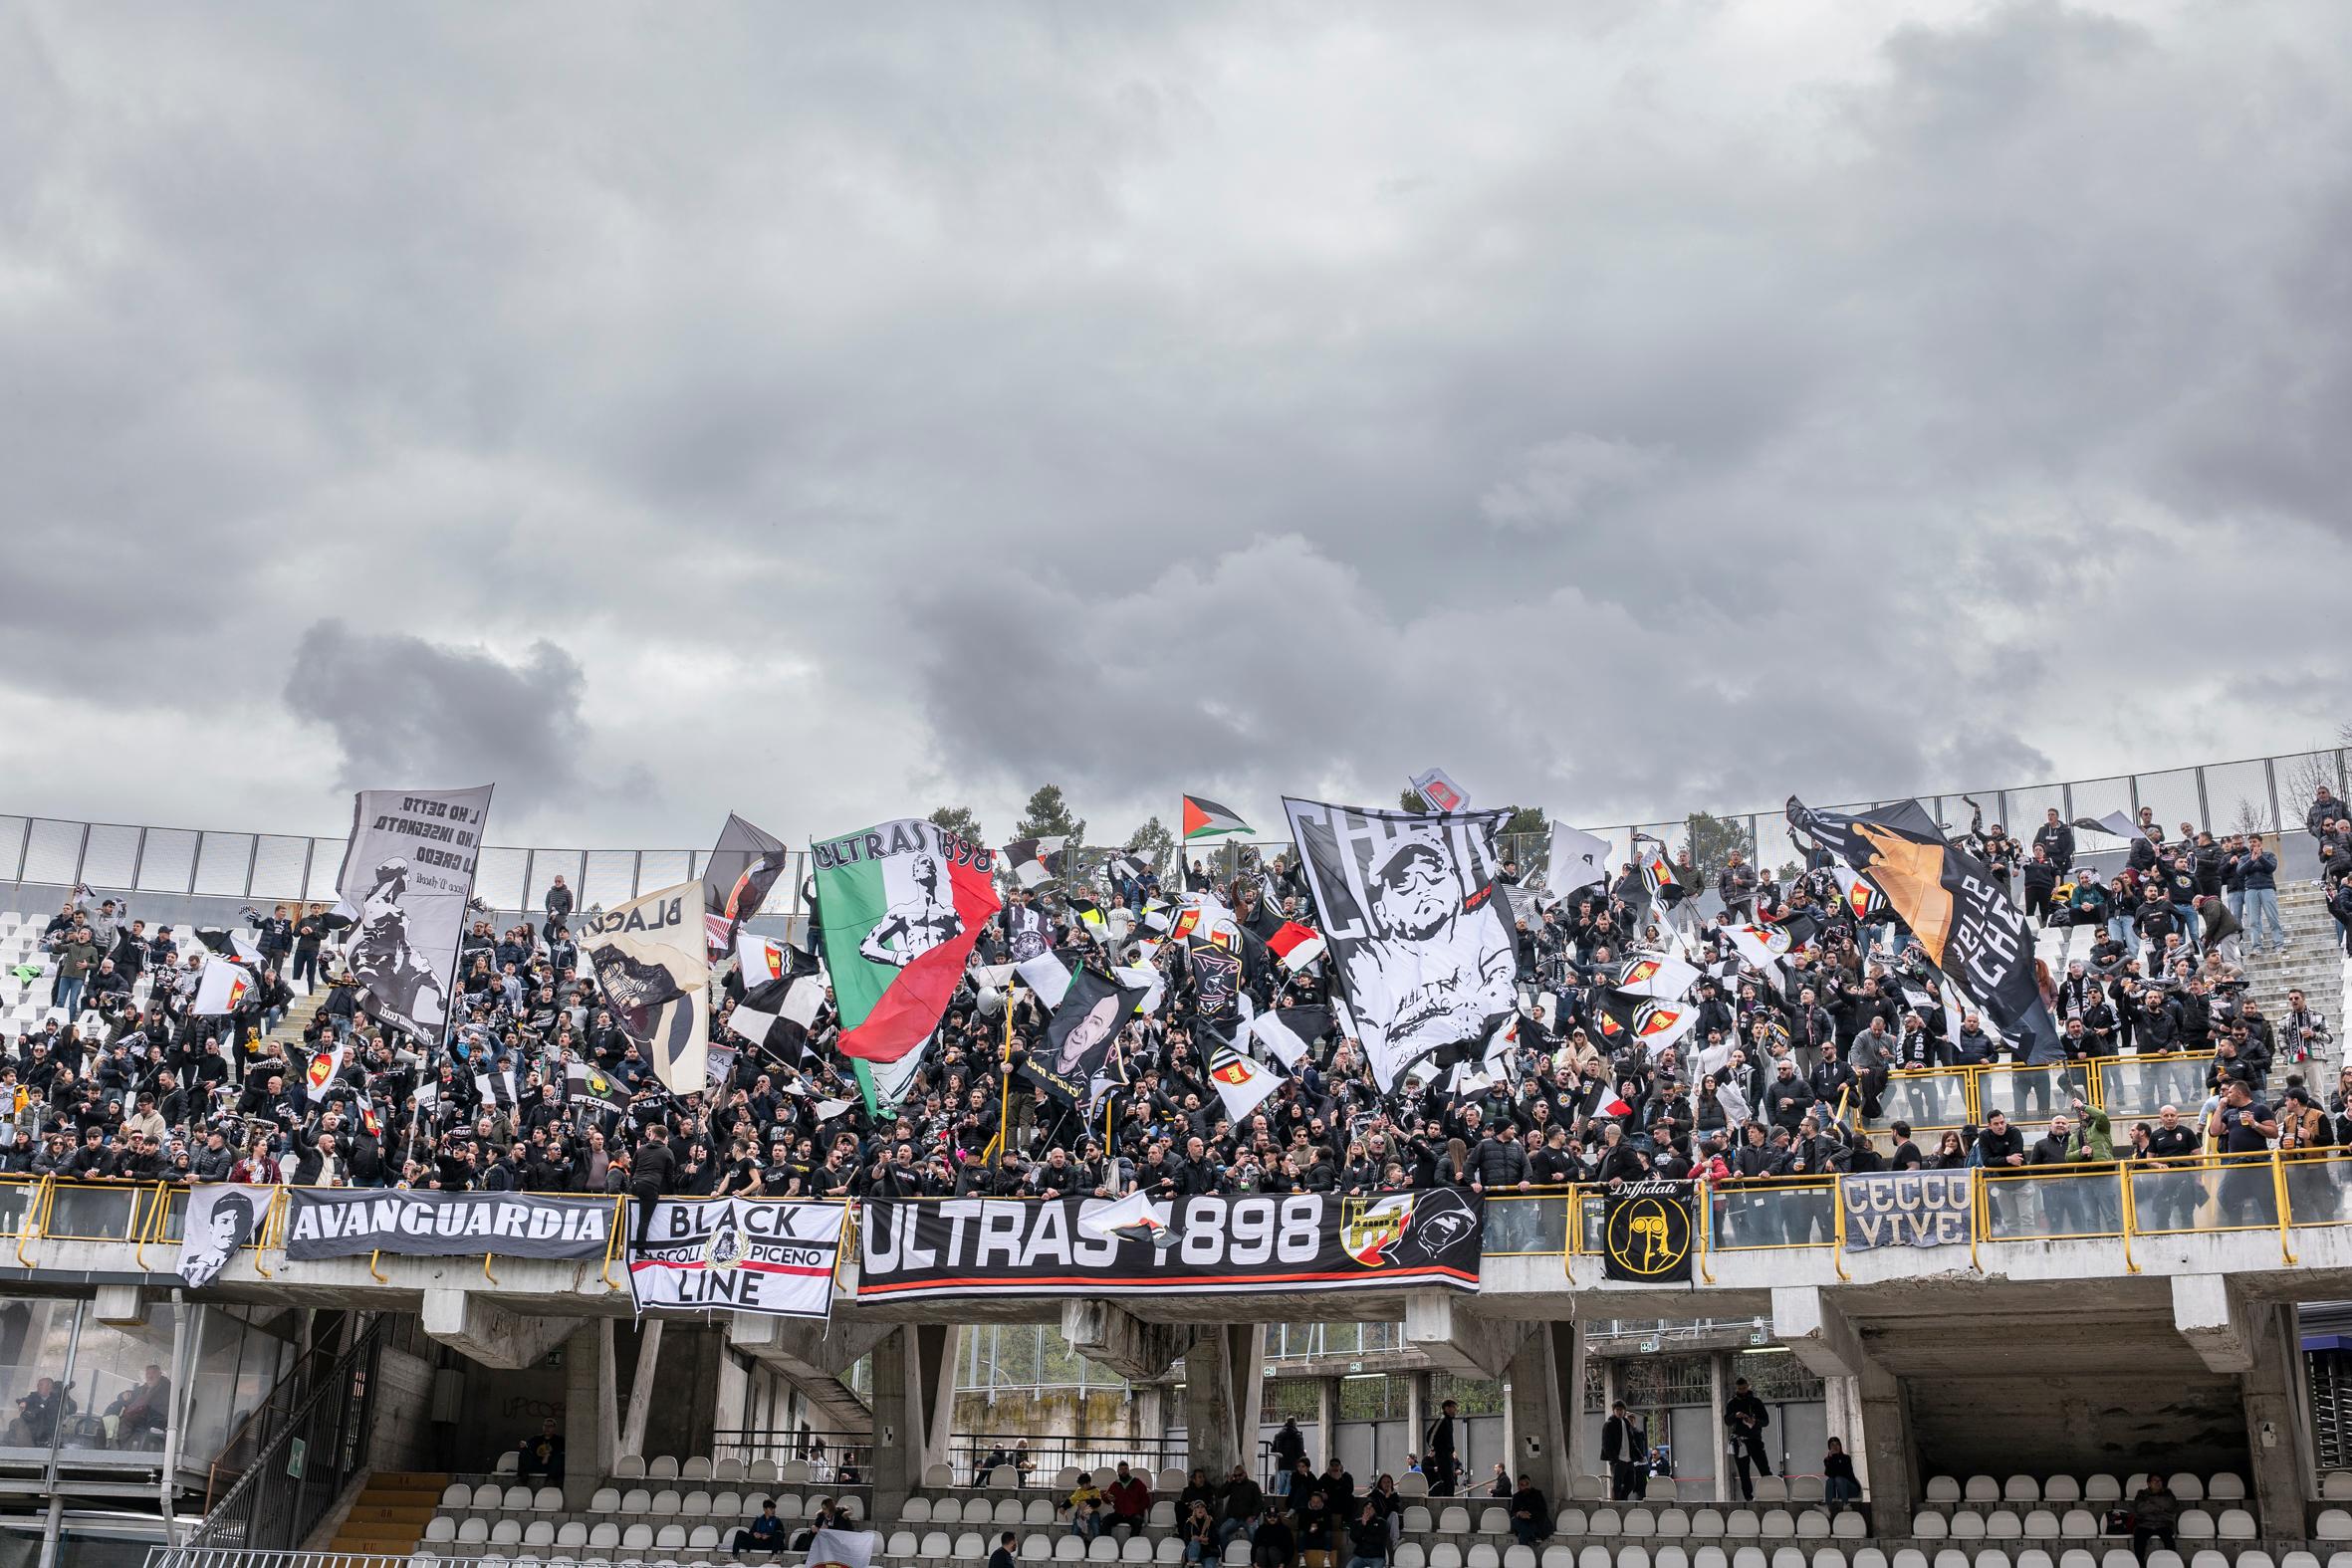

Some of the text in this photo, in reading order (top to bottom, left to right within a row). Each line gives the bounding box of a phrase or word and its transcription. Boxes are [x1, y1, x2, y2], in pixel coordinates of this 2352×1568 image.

[813, 820, 993, 873] ULTRAS 1898
[1609, 1181, 1679, 1199] Diffidati
[1844, 1175, 1972, 1214] CECCO
[292, 1199, 604, 1240] AVANGUARDIA
[670, 1201, 801, 1237] BLACK
[862, 1198, 1120, 1274] ULTRAS
[1856, 1212, 1964, 1247] VIVE
[750, 1245, 822, 1265] PICENO
[679, 1269, 764, 1306] LINE
